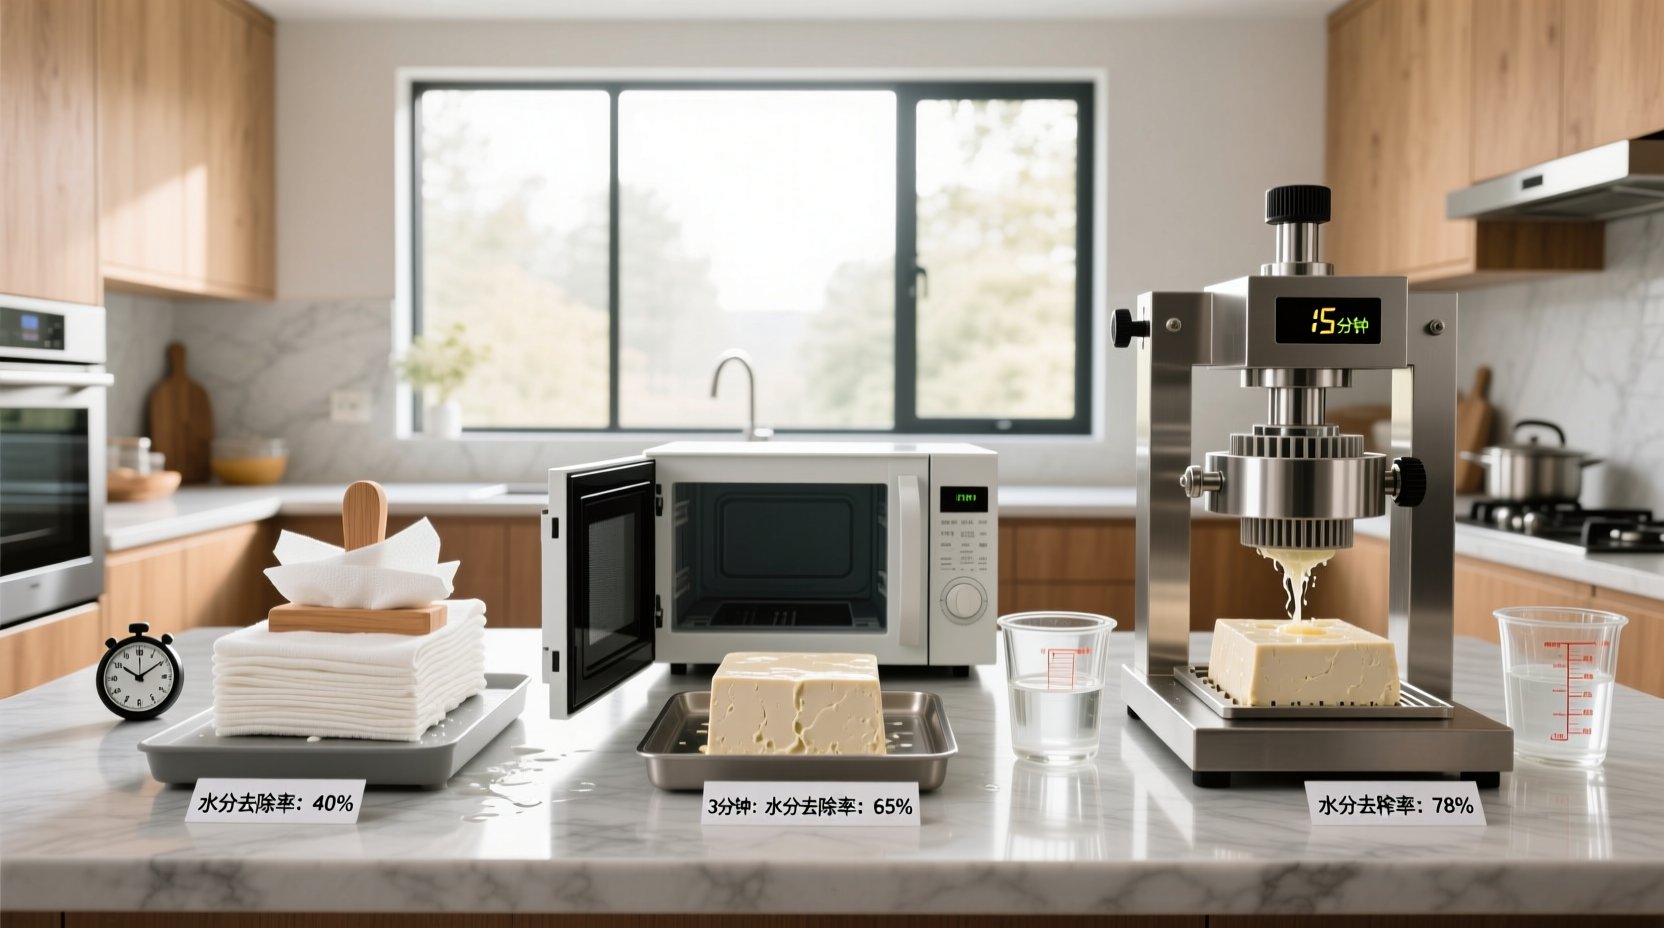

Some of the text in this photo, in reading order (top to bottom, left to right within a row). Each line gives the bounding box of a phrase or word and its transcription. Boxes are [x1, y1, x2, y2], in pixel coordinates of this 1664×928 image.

[198, 792, 354, 814] 水分去除率： 40%
[764, 796, 863, 817] 水分去除率：
[873, 797, 913, 815] 65%
[1431, 796, 1474, 814] 78%
